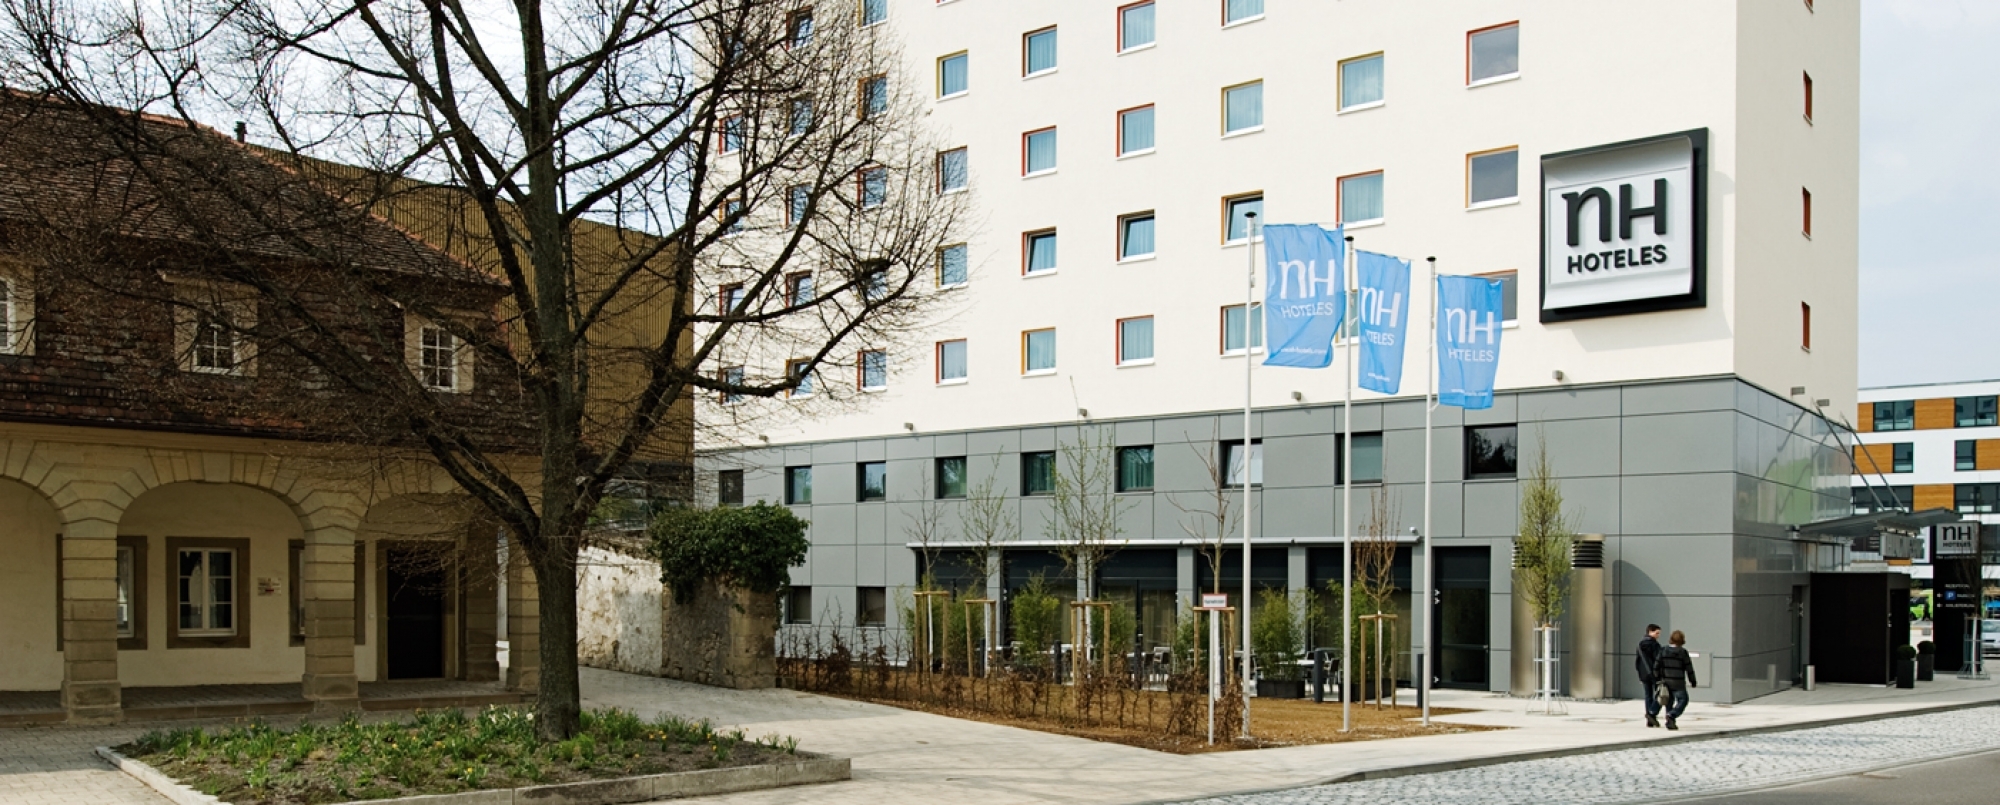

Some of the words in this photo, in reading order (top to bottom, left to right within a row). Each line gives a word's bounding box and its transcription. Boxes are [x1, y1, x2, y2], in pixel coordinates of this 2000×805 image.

[1561, 178, 1667, 247] nH
[1567, 244, 1668, 274] HOTELES
[1281, 301, 1334, 318] HOTELES
